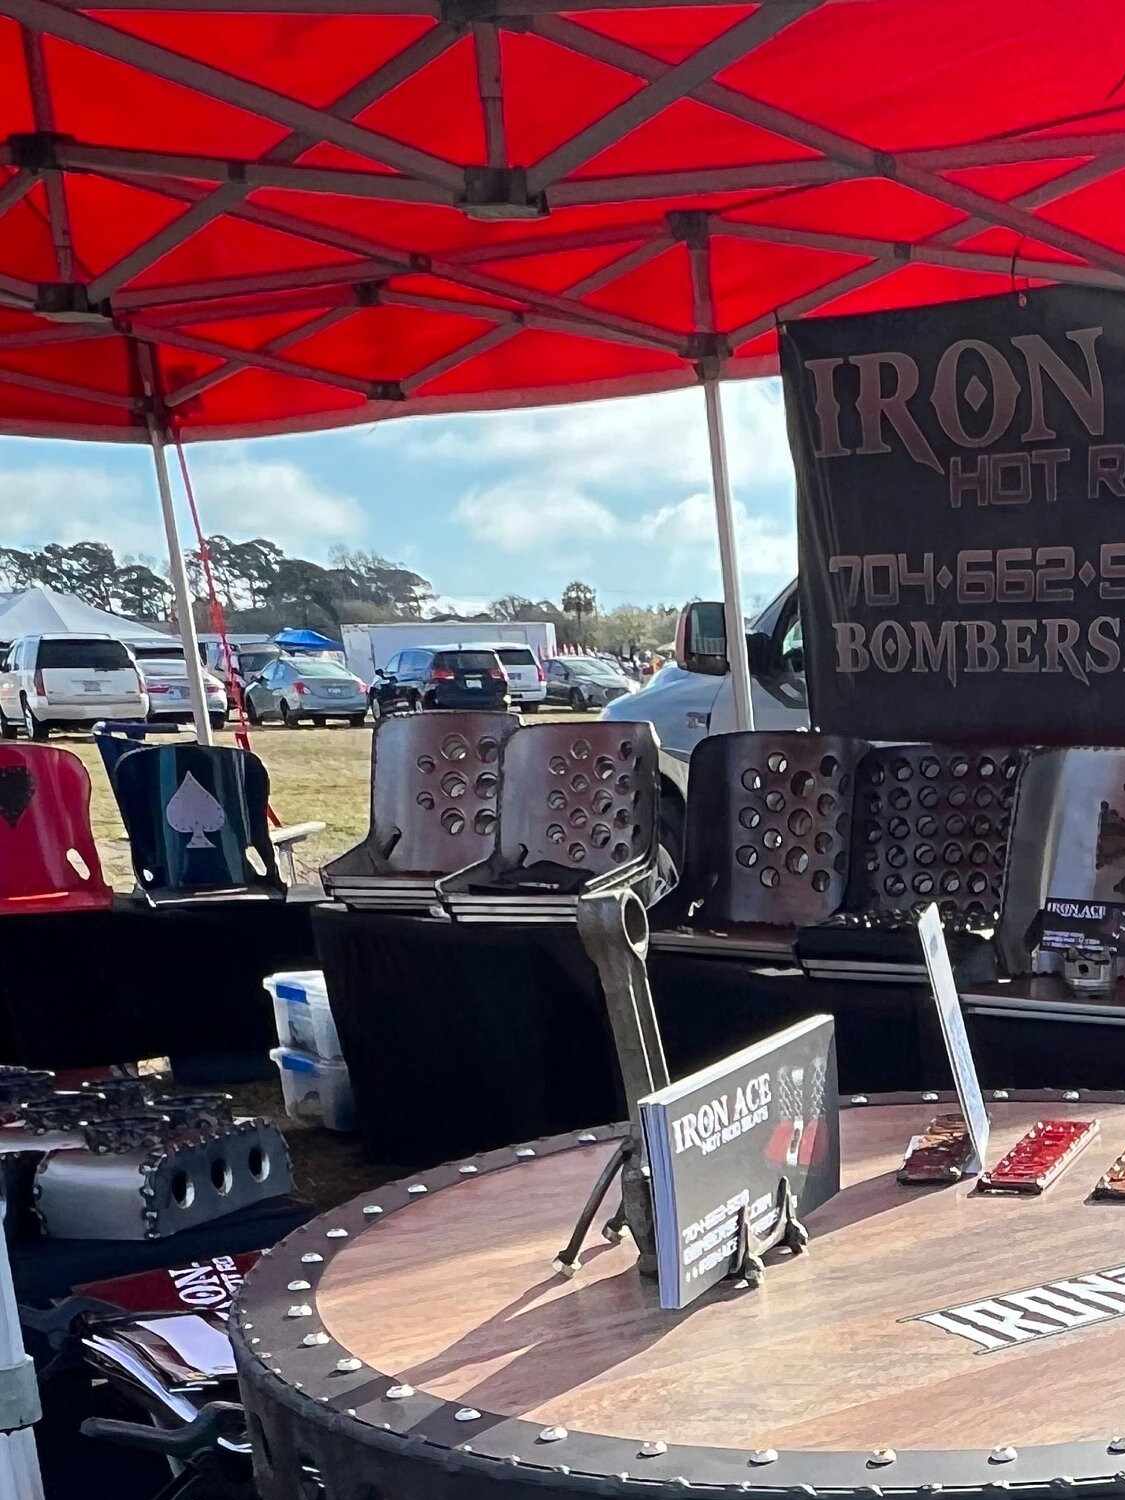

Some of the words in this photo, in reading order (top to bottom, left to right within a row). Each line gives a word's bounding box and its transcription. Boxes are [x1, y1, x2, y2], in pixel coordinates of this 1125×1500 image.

[804, 326, 1105, 474] IRON
[949, 448, 1070, 508] HOT
[672, 1095, 728, 1153] IRON
[733, 1073, 771, 1121] ACE
